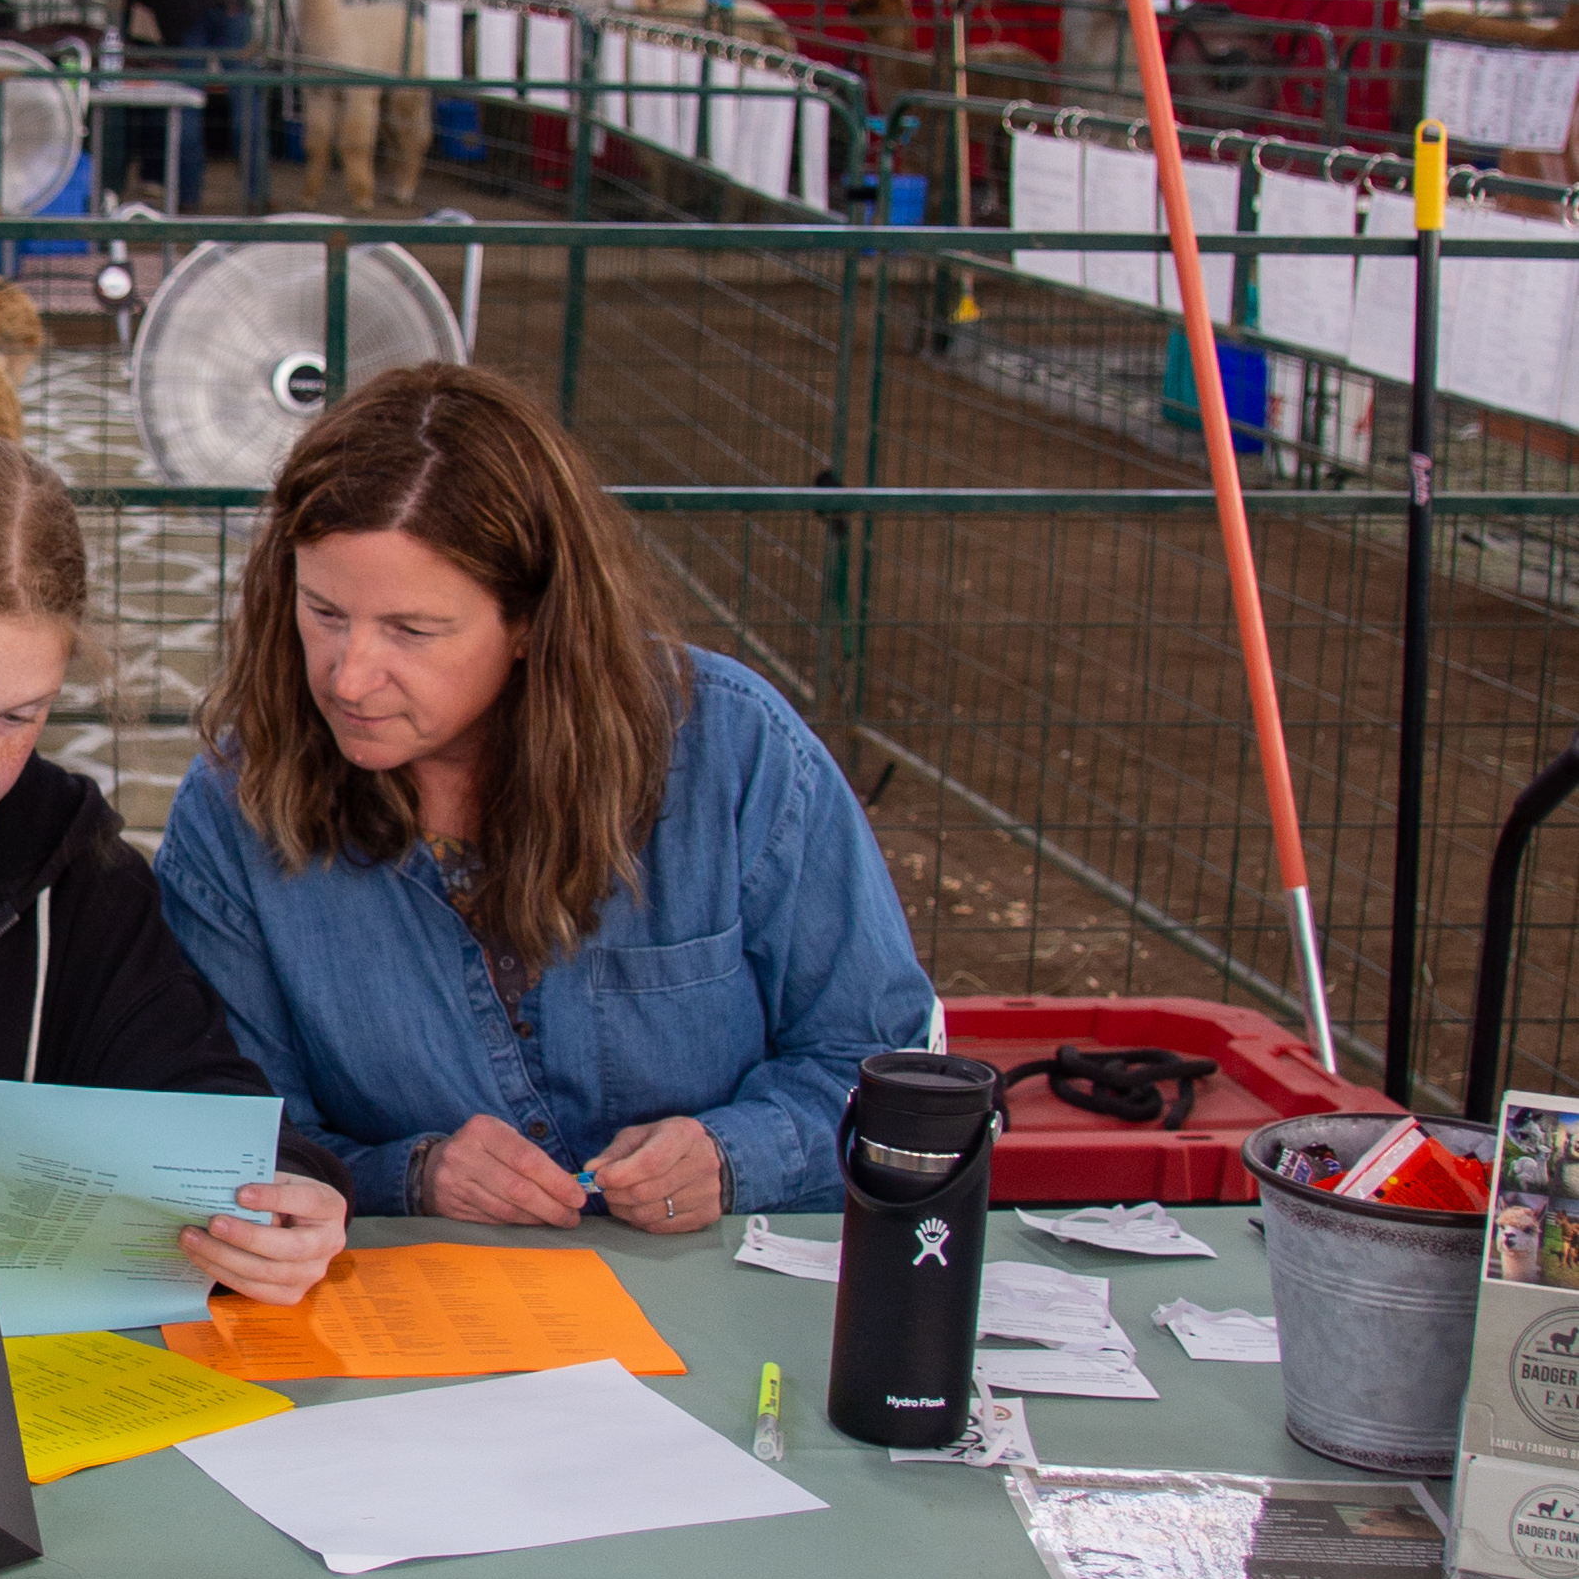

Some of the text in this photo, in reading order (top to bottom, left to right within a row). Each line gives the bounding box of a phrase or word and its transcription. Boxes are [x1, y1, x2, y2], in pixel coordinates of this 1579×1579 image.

[1520, 1363, 1578, 1387] BADGER
[886, 1394, 946, 1409] Hydro Flask
[1525, 1441, 1569, 1459] FARMING
[1517, 1522, 1557, 1540] BADGER
